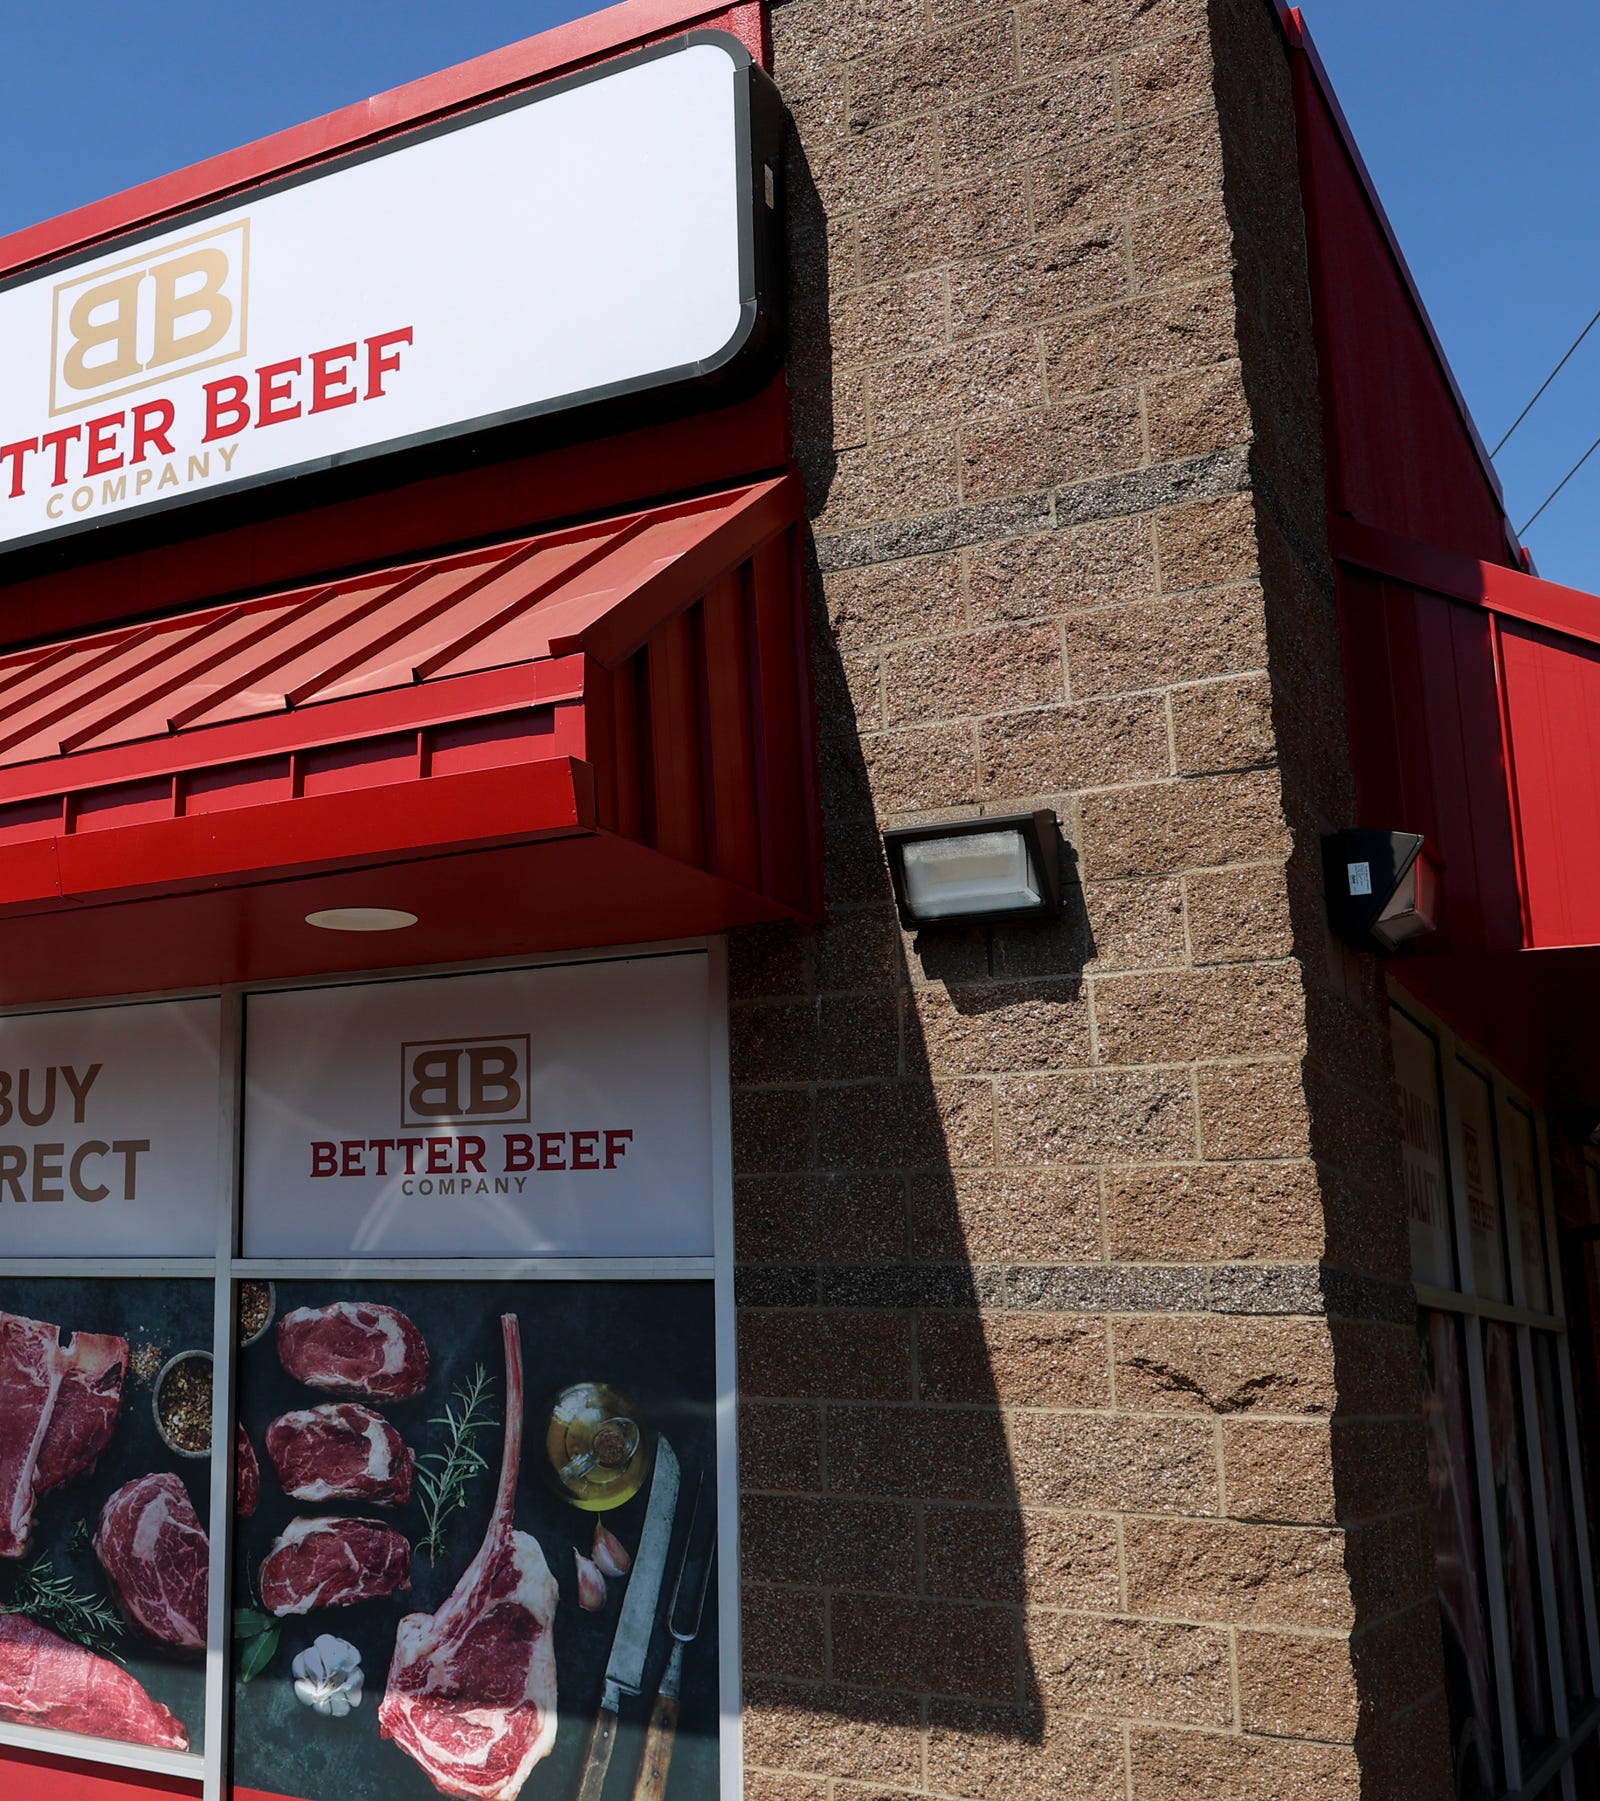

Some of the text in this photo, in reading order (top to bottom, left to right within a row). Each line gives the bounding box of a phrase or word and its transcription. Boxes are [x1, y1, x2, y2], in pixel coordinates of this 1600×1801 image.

[201, 325, 413, 444] BEEF
[46, 443, 239, 520] COMPANY
[310, 1129, 633, 1178] BETTER BEEF
[402, 1177, 528, 1196] COMPANY
